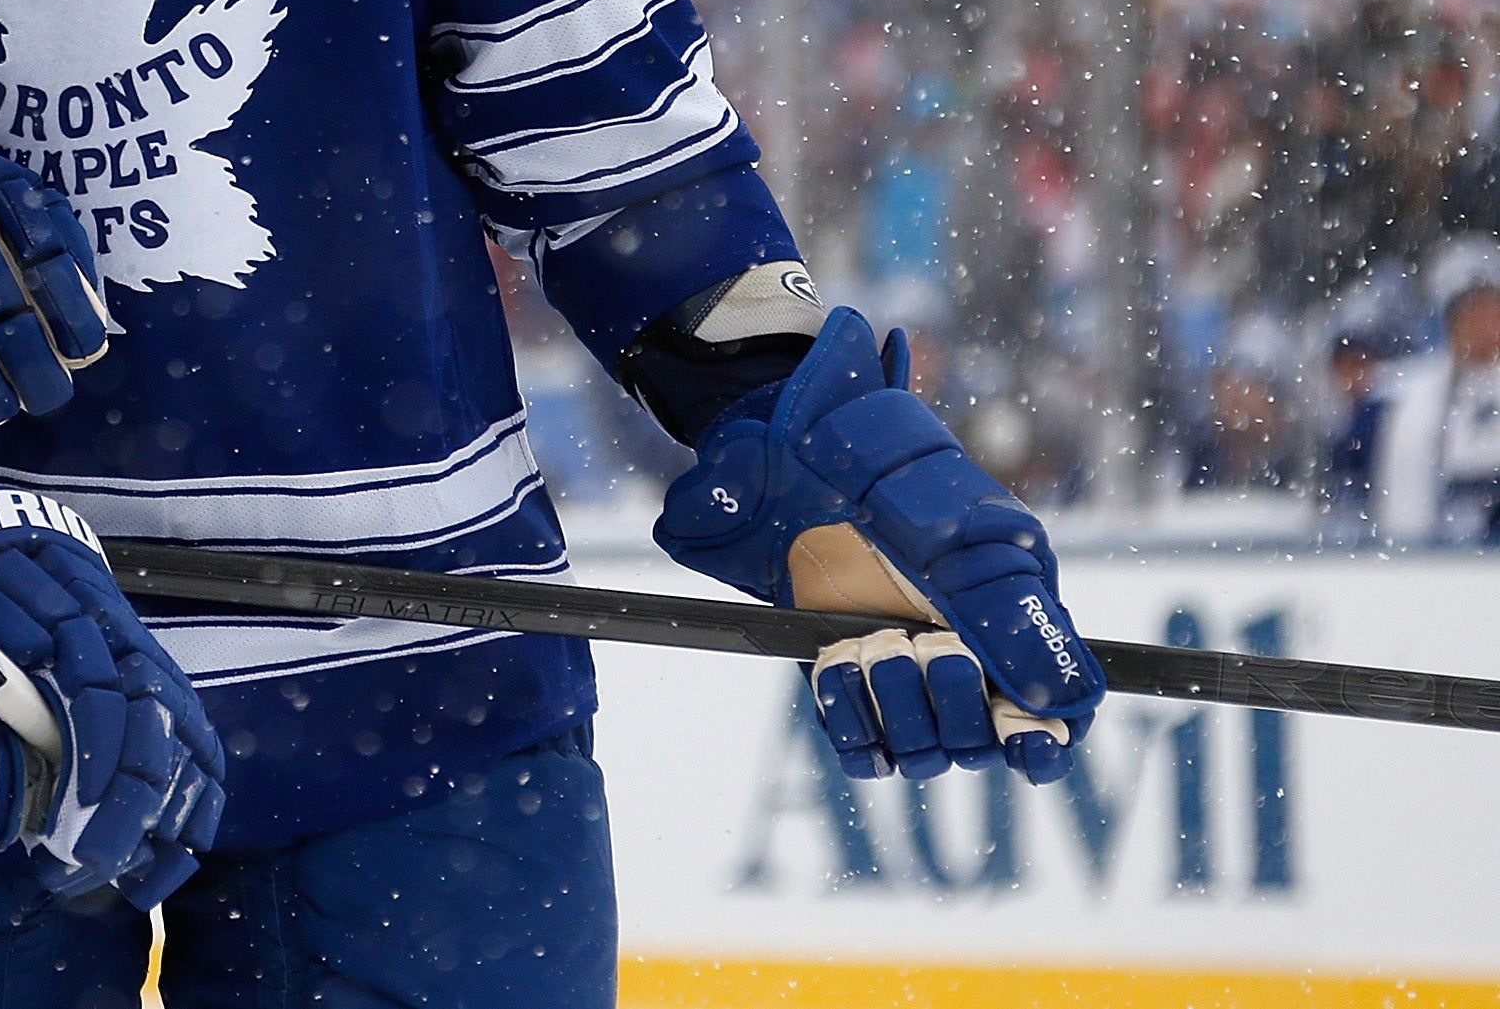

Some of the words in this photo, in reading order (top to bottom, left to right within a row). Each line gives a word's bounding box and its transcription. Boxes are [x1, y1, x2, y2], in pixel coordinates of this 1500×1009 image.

[711, 487, 739, 515] 3
[309, 592, 366, 614] TRI
[382, 600, 521, 628] MATRIX
[1019, 595, 1080, 685] Reebok
